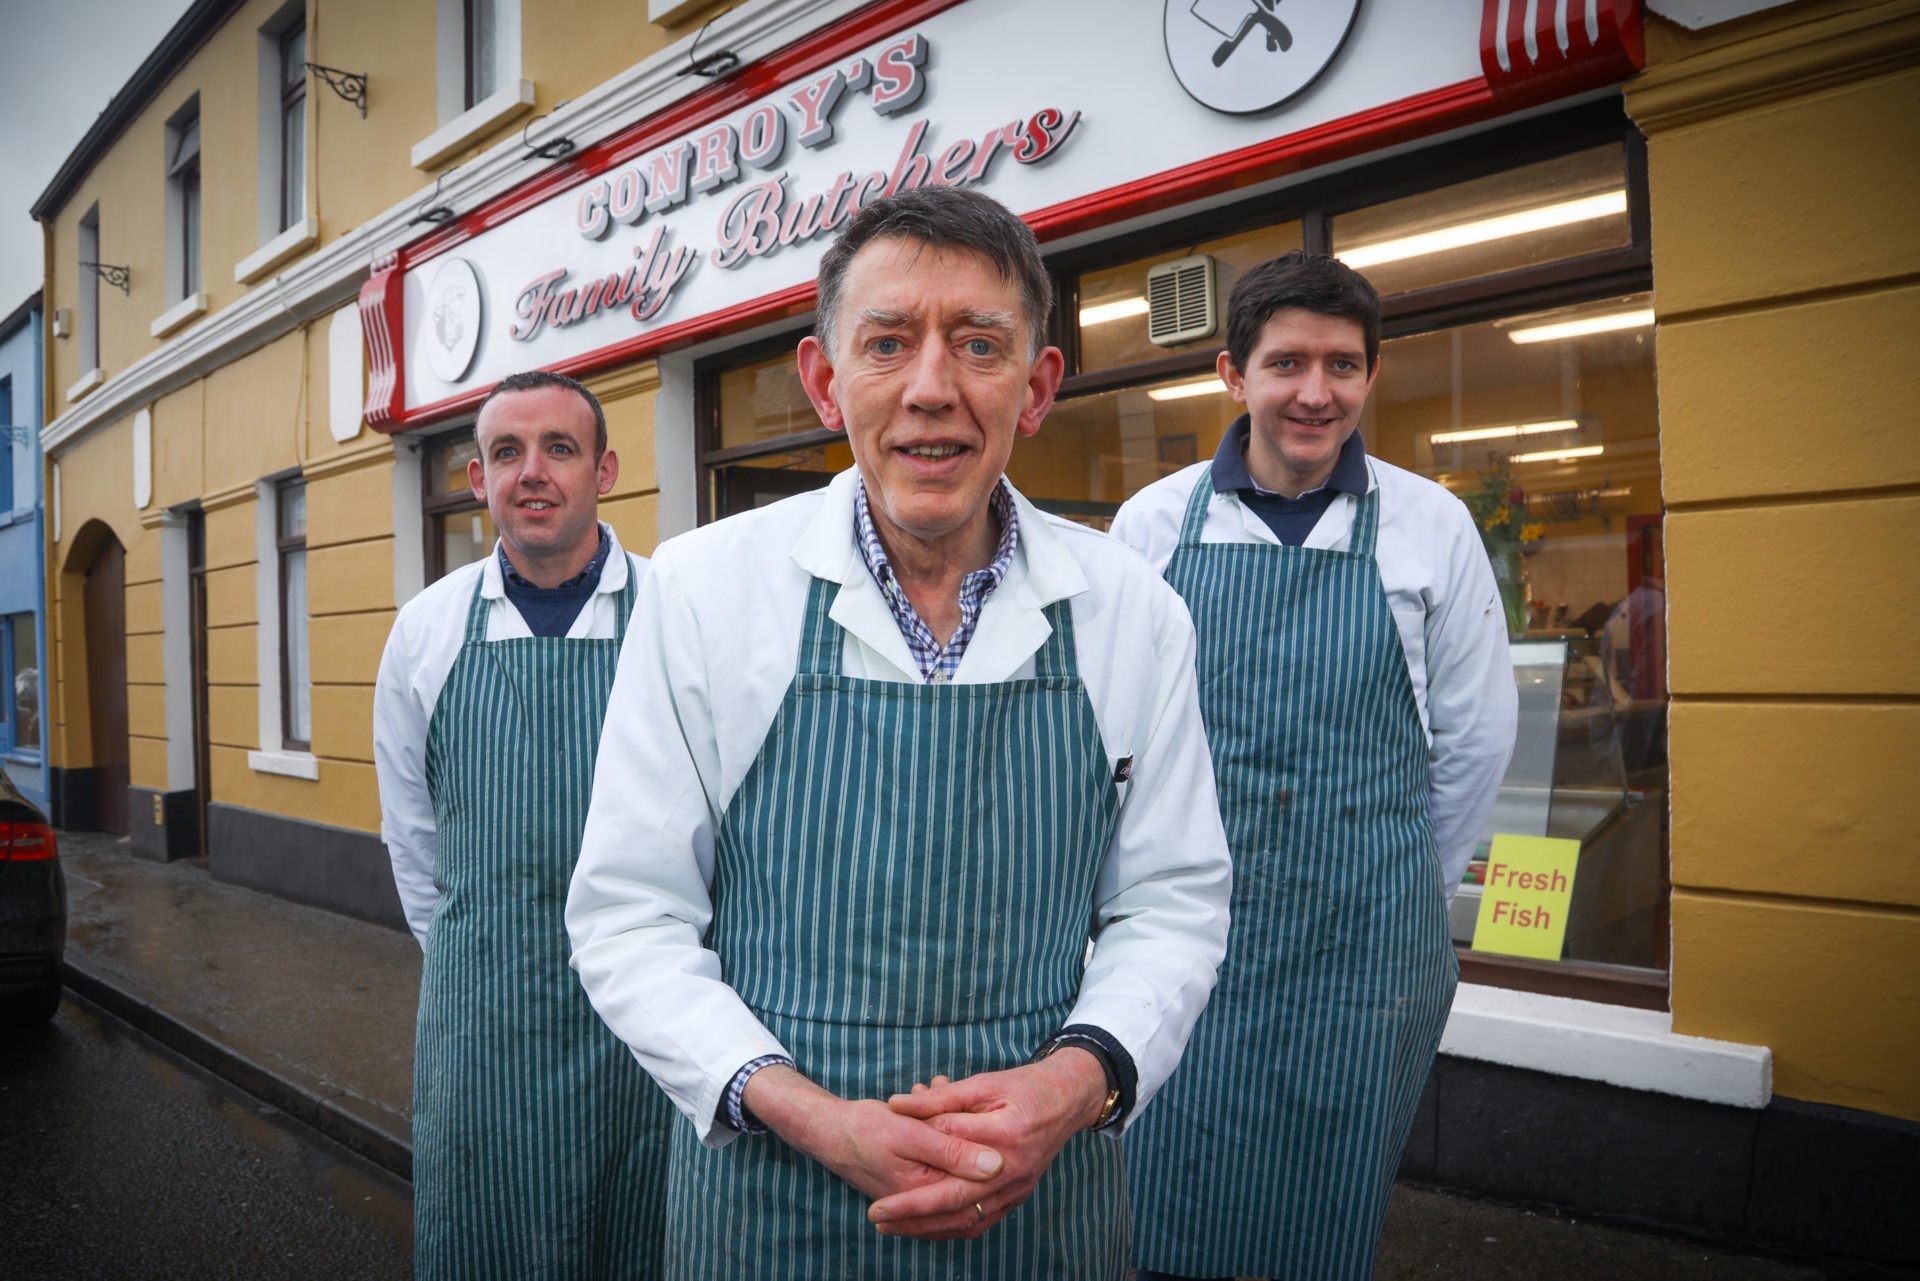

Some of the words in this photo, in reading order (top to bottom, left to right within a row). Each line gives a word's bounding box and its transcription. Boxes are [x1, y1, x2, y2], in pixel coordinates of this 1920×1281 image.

[576, 32, 929, 241] CONROY'S
[510, 225, 699, 342] Family
[711, 108, 1082, 269] Butchers
[1490, 863, 1568, 893] Fresh
[1492, 901, 1551, 930] Fish
